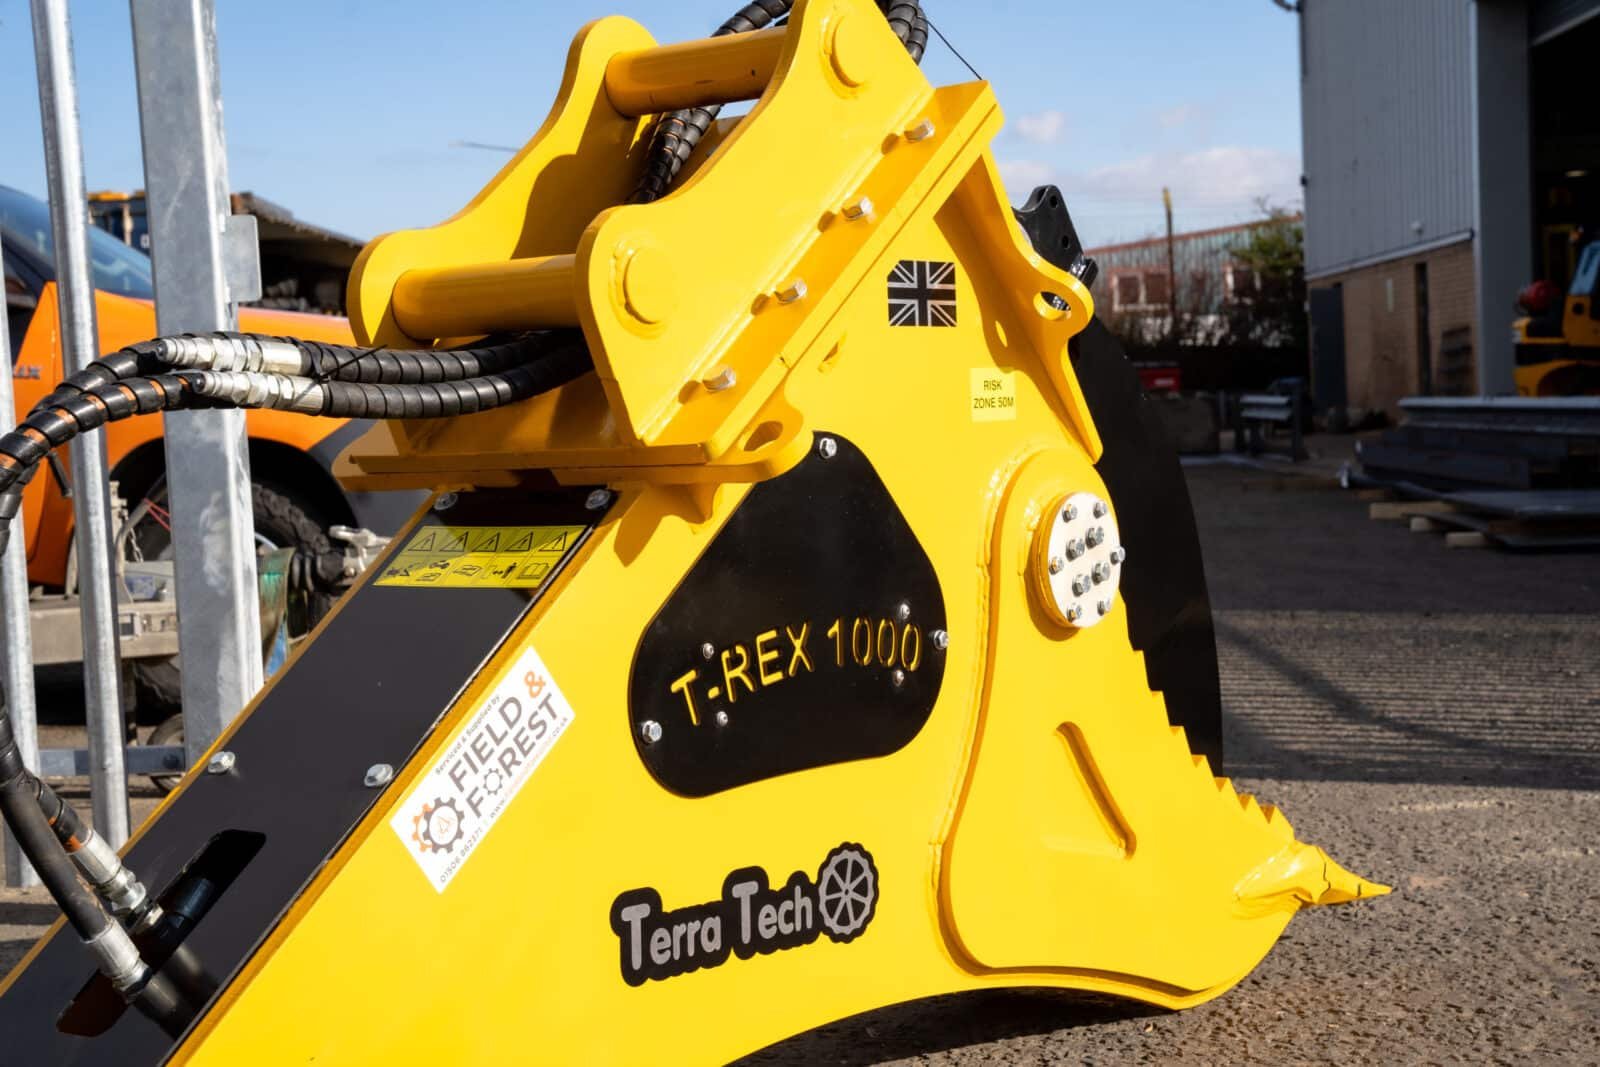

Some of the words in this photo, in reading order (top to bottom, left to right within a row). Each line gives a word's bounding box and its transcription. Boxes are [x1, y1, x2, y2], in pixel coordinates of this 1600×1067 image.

[973, 397, 996, 409] ZONE
[998, 396, 1014, 408] 50M
[984, 380, 1002, 391] RISK
[670, 622, 814, 726] T-REX
[827, 617, 921, 671] 1000
[448, 696, 522, 793] FIELD
[524, 671, 546, 698] &
[621, 903, 722, 971] Terra
[732, 880, 813, 944] Tech
